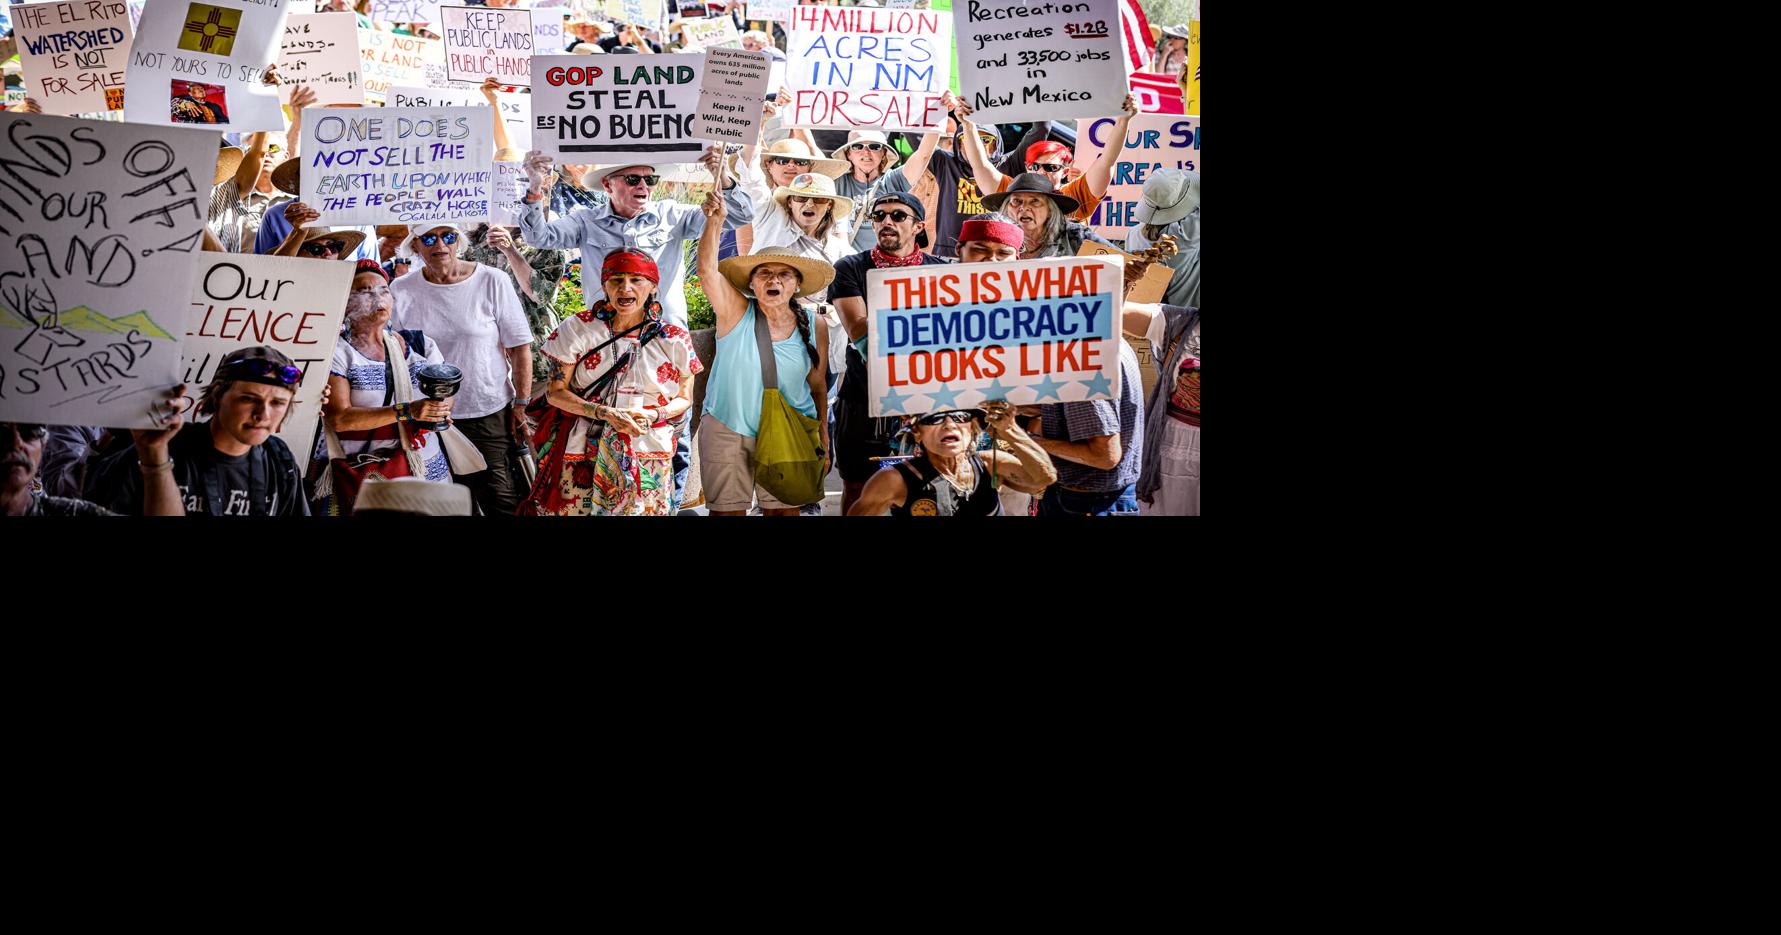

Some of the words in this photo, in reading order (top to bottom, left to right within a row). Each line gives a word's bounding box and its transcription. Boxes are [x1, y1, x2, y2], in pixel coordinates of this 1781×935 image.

[10, 6, 50, 28] THE
[57, 3, 85, 23] EL
[85, 1, 125, 20] RITO
[466, 12, 505, 30] KEEP
[968, 0, 1090, 22] Recreation
[22, 27, 124, 55] WATERSHED
[392, 38, 426, 53] NOT
[448, 29, 491, 48] PUBLIC
[494, 31, 531, 50] LANDS
[974, 28, 1053, 50] generates
[1064, 20, 1109, 35] $1.2B
[53, 54, 68, 69] IS
[75, 47, 114, 67] NOT
[712, 50, 732, 58] Every
[733, 52, 765, 61] American
[804, 35, 932, 62] ACRES
[977, 53, 1008, 69] and
[1017, 49, 1071, 66] 33,500
[1075, 49, 1111, 63] jobs
[134, 52, 166, 68] NOT
[171, 56, 208, 76] YOURS
[217, 62, 232, 79] TO
[451, 54, 492, 74] PUBLIC
[739, 71, 760, 79] public
[742, 62, 766, 70] million
[812, 61, 853, 87] IN
[870, 62, 934, 91] NM
[1027, 67, 1047, 78] in
[41, 77, 77, 97] FOR
[77, 71, 125, 91] SALE
[546, 66, 603, 87] GOP
[614, 66, 695, 86] LAND
[566, 89, 676, 110] STEAL
[712, 102, 735, 112] Keep
[738, 104, 745, 112] it
[795, 90, 860, 126] FOR
[858, 93, 941, 127] SALE
[975, 87, 1014, 111] New
[1022, 84, 1092, 105] Mexico
[315, 116, 383, 144] ONE
[398, 117, 470, 139] DOES
[537, 116, 555, 126] ES
[559, 116, 601, 139] NO
[702, 113, 725, 123] Wild,
[728, 116, 751, 127] Keep
[706, 126, 712, 134] it
[715, 127, 743, 137] Public
[313, 149, 368, 168] NOT
[368, 146, 425, 167] SELL
[429, 143, 465, 162] THE
[316, 173, 385, 195] EARTH
[392, 172, 451, 190] UPON
[453, 171, 491, 185] WHICH
[41, 191, 110, 229] OUR
[121, 140, 203, 258] OFF!
[323, 196, 357, 211] THE
[365, 189, 426, 207] PEOPLE
[437, 186, 486, 200] WALK
[390, 200, 441, 213] CRAZY
[447, 200, 488, 210] HORSE
[203, 262, 294, 301] Our
[883, 274, 961, 311] THIS
[970, 270, 1002, 305] IS
[1007, 264, 1105, 301] WHAT
[186, 303, 326, 345] LENCE
[887, 300, 1102, 349] DEMOCRACY
[887, 344, 1006, 387] LOOKS
[1020, 337, 1103, 377] LIKE
